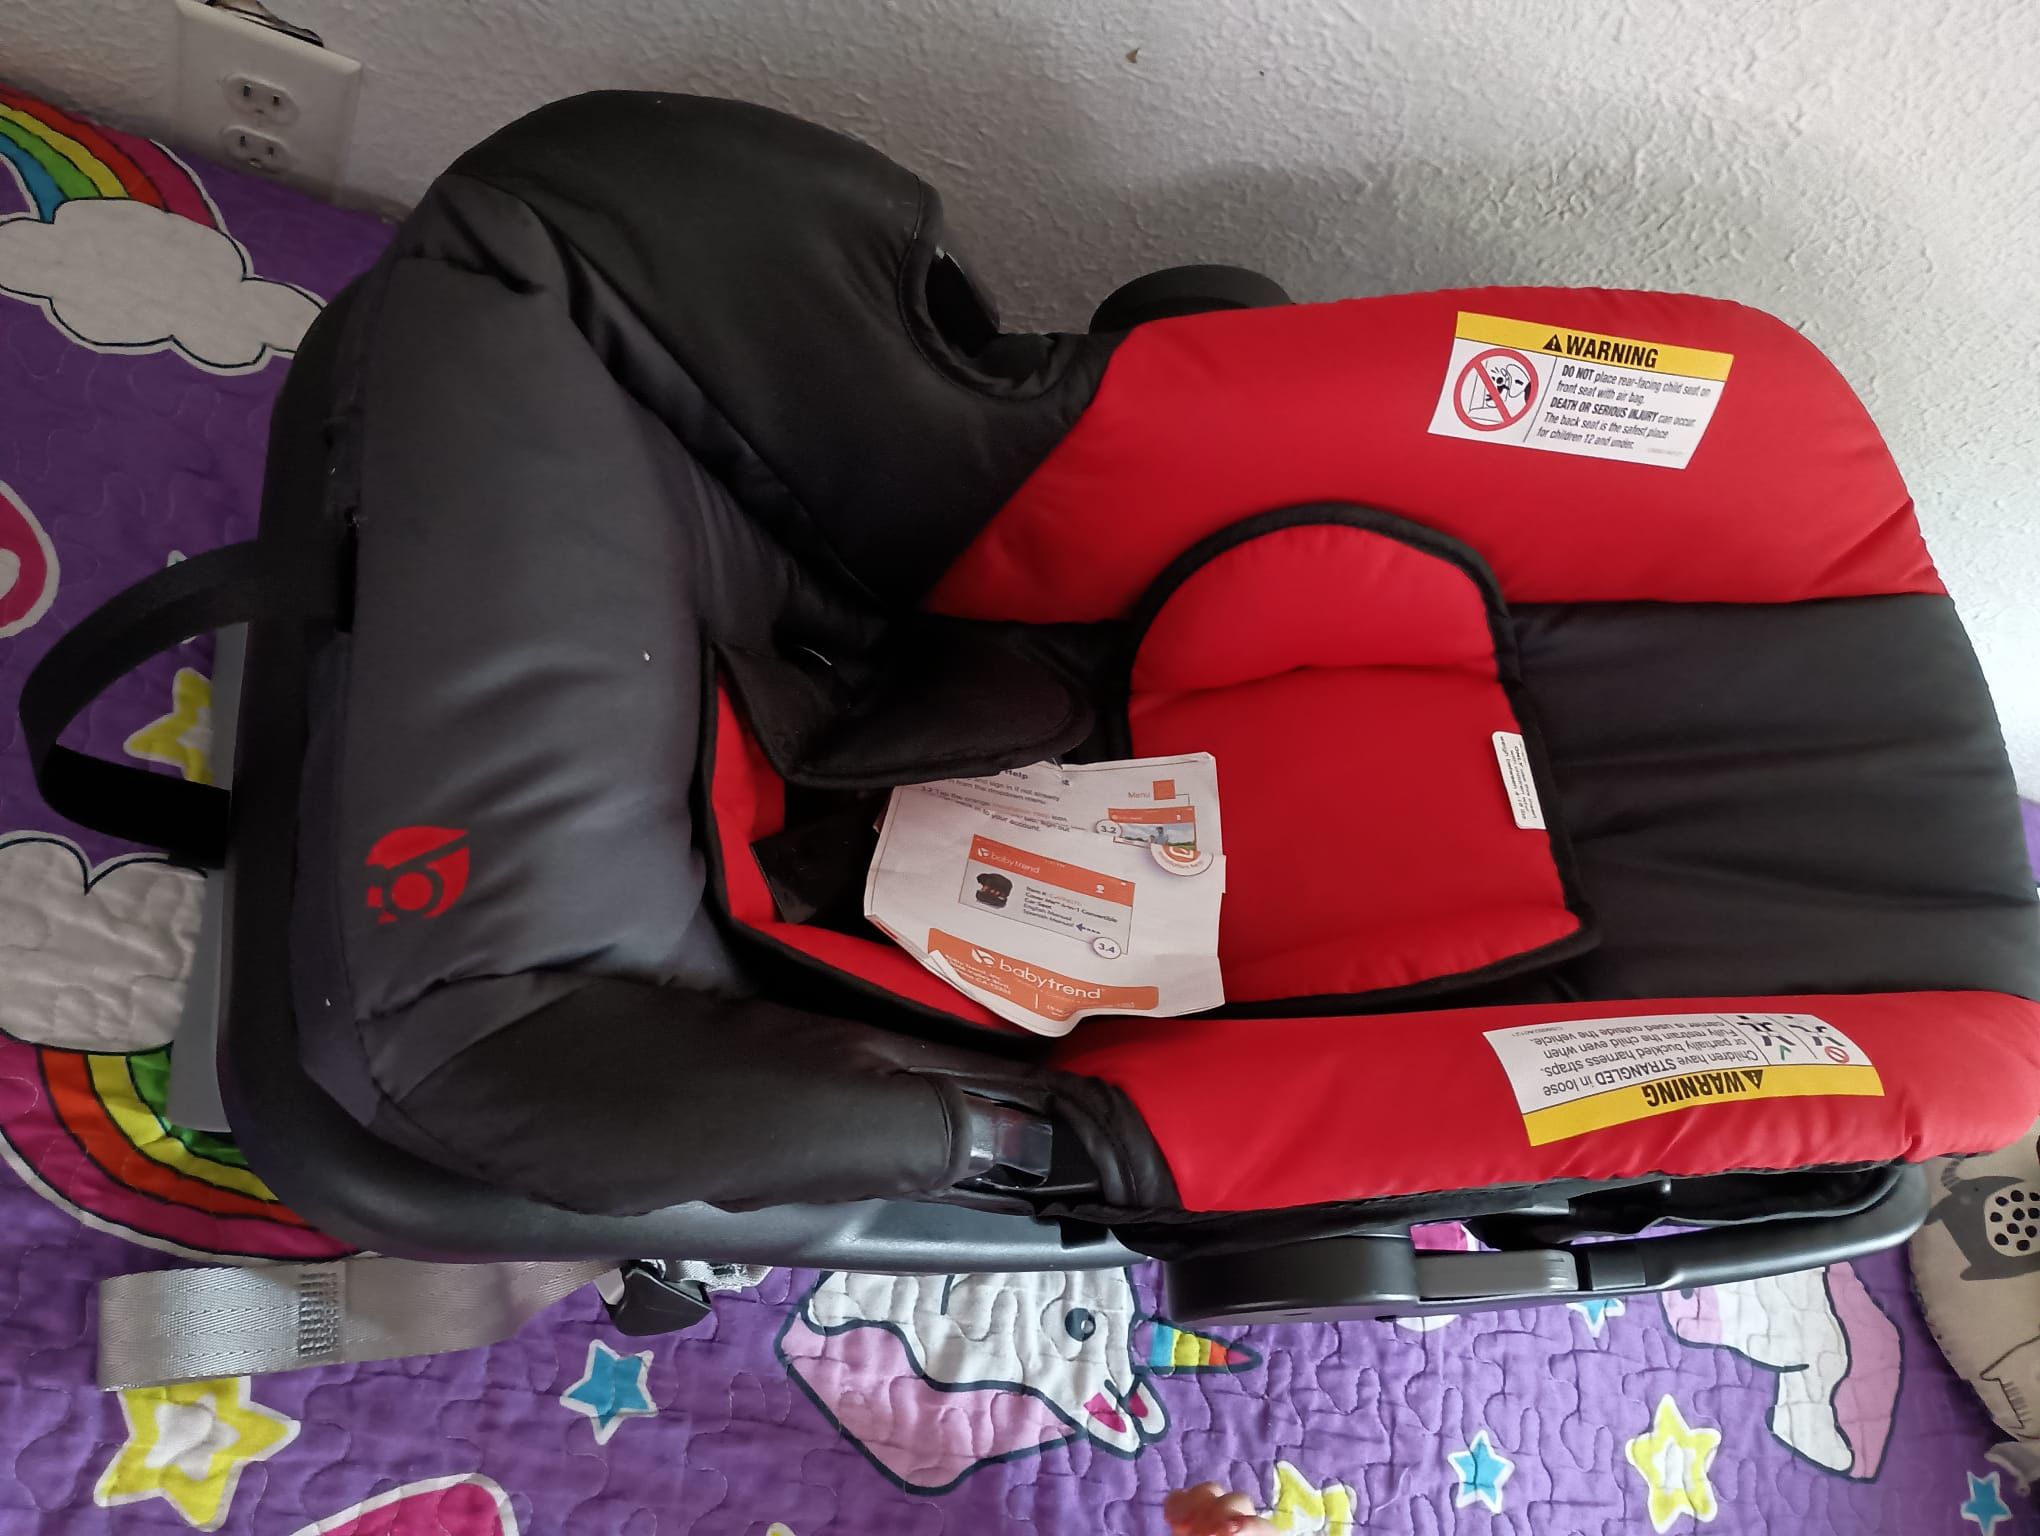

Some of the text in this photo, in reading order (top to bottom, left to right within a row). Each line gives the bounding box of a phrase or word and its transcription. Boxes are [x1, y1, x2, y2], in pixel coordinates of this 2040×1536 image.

[1566, 335, 1659, 368] WARNING
[1556, 382, 1578, 395] front
[1577, 386, 1598, 398] seat
[1597, 389, 1616, 400] with
[1616, 391, 1629, 401] air
[1561, 365, 1576, 378] DO
[1576, 367, 1595, 381] NOT
[1594, 371, 1618, 385] place
[1618, 376, 1662, 394] rear-facing
[1662, 381, 1683, 394] child
[1682, 385, 1701, 397] seat
[1549, 396, 1579, 412] DEATH
[1578, 401, 1592, 413] OR
[1591, 403, 1629, 419] SERIOUS
[1628, 408, 1660, 422] INJURY
[1658, 414, 1674, 424] can
[1537, 426, 1550, 438] for
[1549, 429, 1583, 443] children
[1583, 433, 1596, 445] 12
[1594, 436, 1612, 447] and
[1544, 411, 1670, 440] The back seat is the safest place
[1100, 825, 1117, 834] 3.2
[1097, 942, 1116, 954] 3.4
[999, 958, 1101, 1000] babytrend
[1529, 1032, 1577, 1047] vehicle.
[1577, 1030, 1600, 1039] the
[1598, 1025, 1643, 1037] outside
[1643, 1023, 1675, 1032] used
[1540, 1037, 1747, 1077] or partially buckled harness straps.
[1543, 1028, 1739, 1059] Fully restrain the child even when
[1542, 1049, 1759, 1097] Children have STRANGLED in loose
[1641, 1071, 1747, 1107] WARNING
